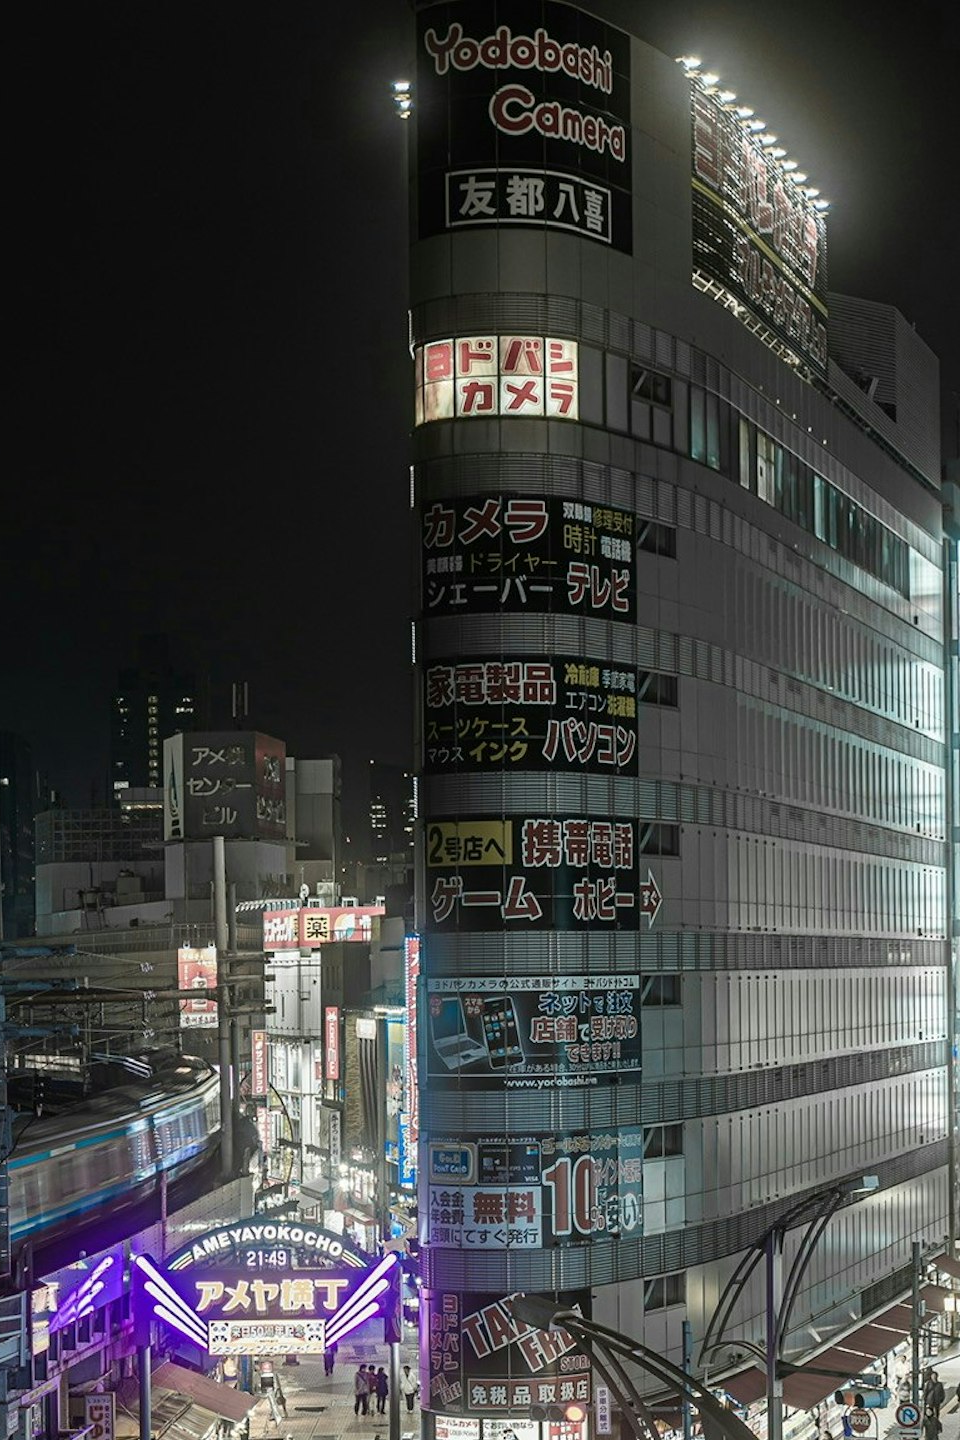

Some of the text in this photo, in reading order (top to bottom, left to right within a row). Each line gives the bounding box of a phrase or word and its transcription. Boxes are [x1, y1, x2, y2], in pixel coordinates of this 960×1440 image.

[425, 22, 612, 94] Yodobashi
[489, 84, 626, 163] Camera
[458, 174, 605, 232] 友都八喜
[426, 339, 574, 380] ヨドバシ
[461, 380, 575, 414] カメラ
[424, 498, 548, 549] カメラ
[593, 506, 633, 535] 修理受付
[564, 524, 598, 556] 時計
[471, 552, 558, 573] ドライヤー
[428, 574, 553, 607] シェーバー
[567, 561, 630, 612] テレビ
[427, 662, 557, 708] 家電製品
[565, 691, 607, 712] エアコン
[427, 716, 529, 740] スーツケース
[542, 717, 636, 767] パソコン
[428, 740, 529, 764] マウス インク
[429, 826, 506, 865] 2号店へ
[522, 819, 634, 869] 携帯電話
[432, 876, 635, 922] ゲーム ホビー
[306, 917, 328, 939] 薬
[538, 991, 634, 1016] ネットで注文
[529, 1015, 638, 1044] 店舗で受け取り
[473, 1190, 536, 1225] 無料
[191, 1224, 343, 1261] AMEYAYOKOCHO
[431, 1228, 539, 1245] 店頭にてすぐ発行
[246, 1250, 287, 1267] 21:49
[195, 1278, 349, 1313] アメヤ横丁
[471, 1379, 588, 1405] 免税品取扱店
